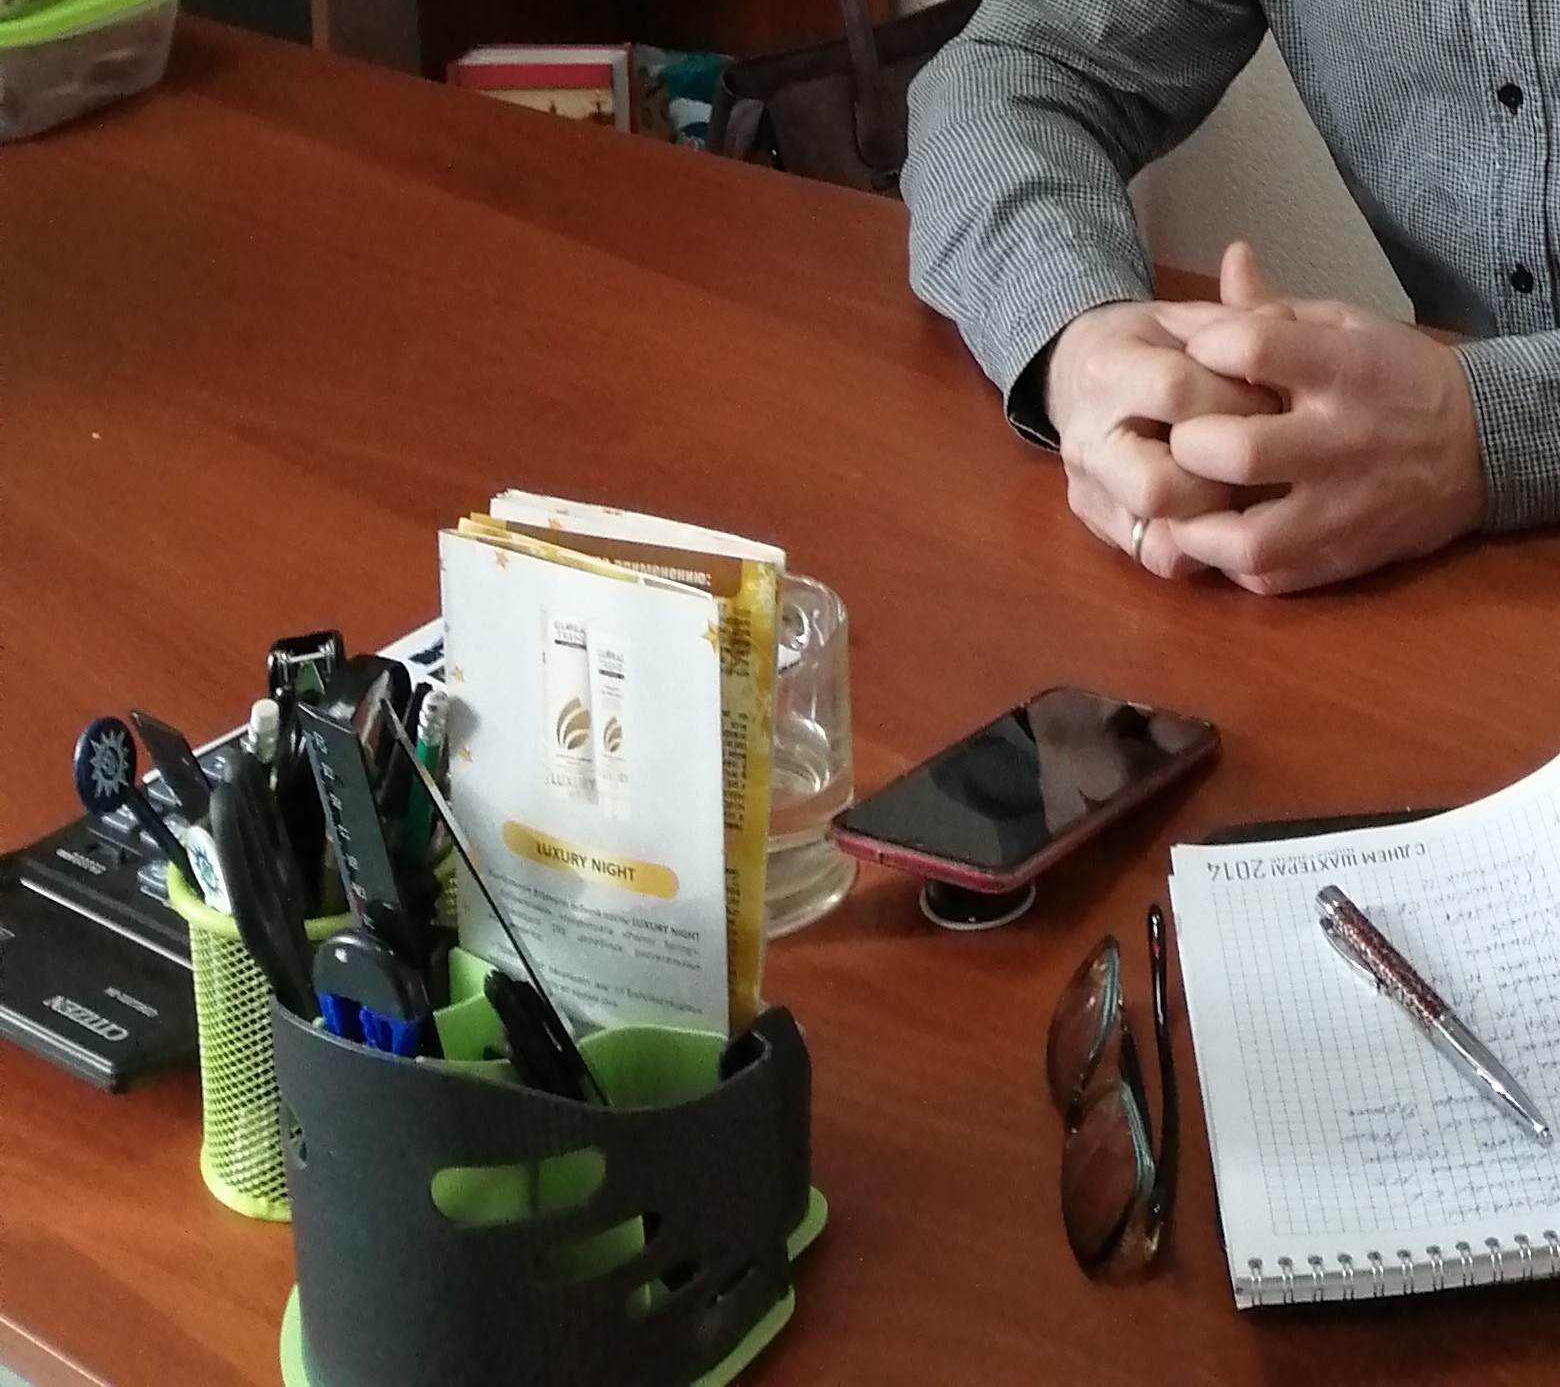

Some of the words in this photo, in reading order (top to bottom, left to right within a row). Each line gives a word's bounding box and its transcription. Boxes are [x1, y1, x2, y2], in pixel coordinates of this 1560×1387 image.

[536, 841, 587, 868] LUXURY
[592, 858, 636, 882] NIGHT
[1271, 852, 1358, 877] ШАХТЕРА!
[1361, 844, 1411, 865] ДНЕМ
[1207, 859, 1267, 882] 2014
[43, 995, 129, 1042] CITIZEN
